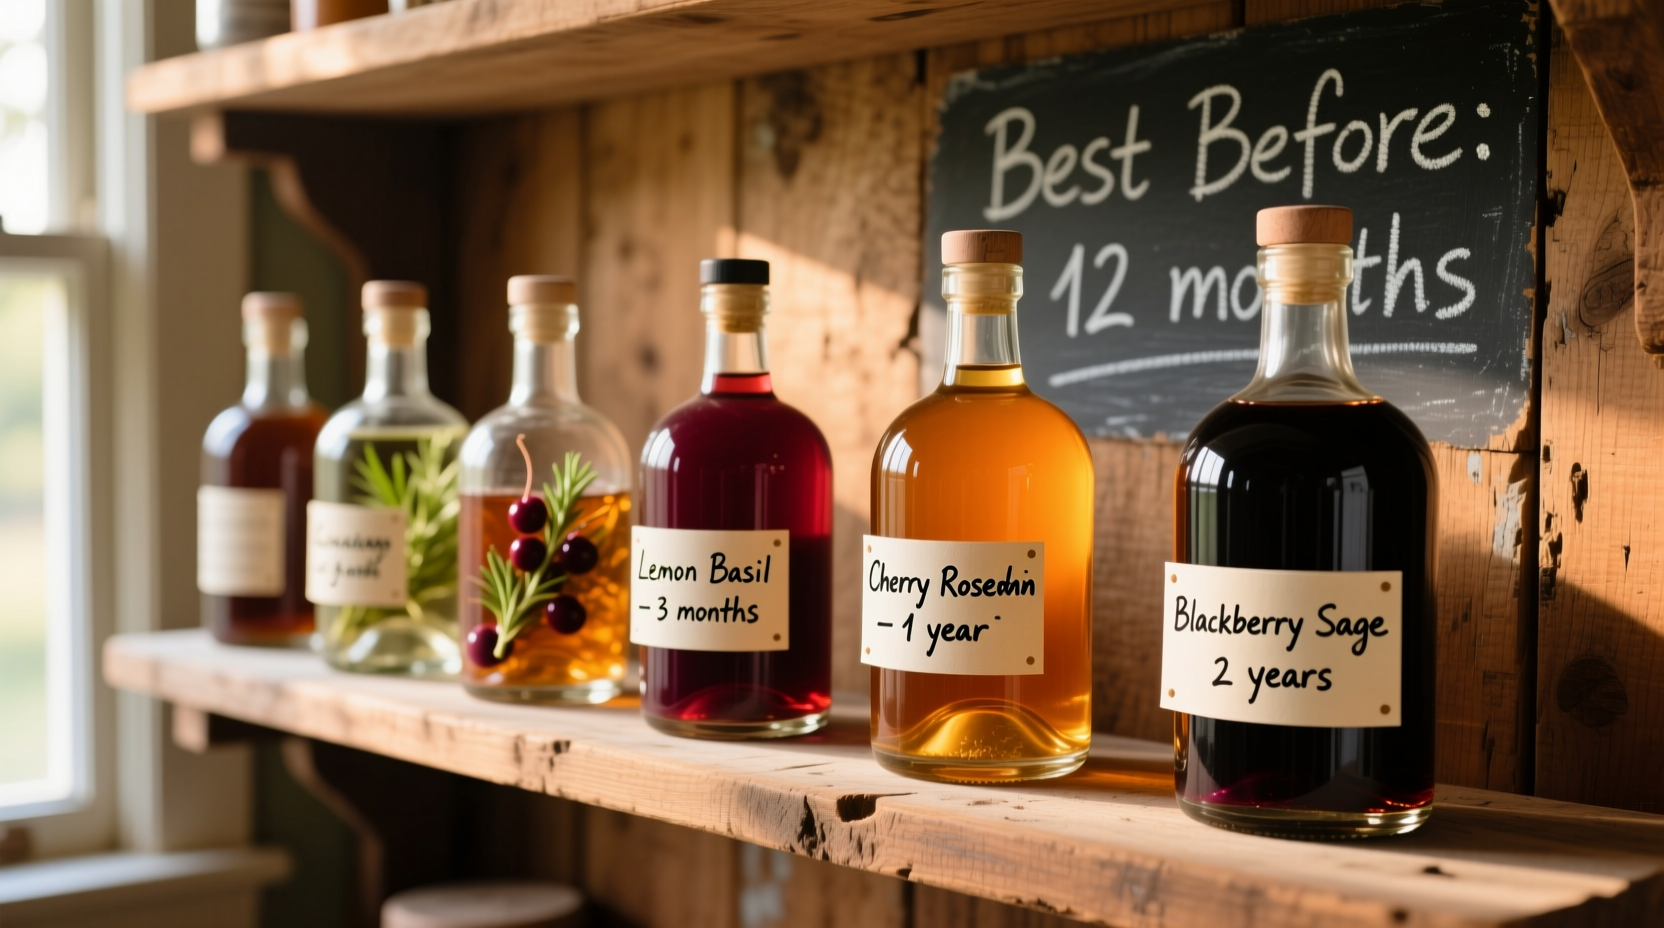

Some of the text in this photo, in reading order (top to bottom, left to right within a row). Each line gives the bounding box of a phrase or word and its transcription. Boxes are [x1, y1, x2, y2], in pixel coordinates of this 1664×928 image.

[983, 68, 1491, 221] Best Before:
[1049, 212, 1477, 338] 12 moths
[638, 548, 771, 584] Lemon Basil
[869, 559, 931, 609] Cherry
[656, 596, 669, 621] 3
[676, 595, 759, 624] months
[902, 612, 915, 642] 1
[1174, 595, 1389, 657] Blackberry Sage
[1211, 656, 1333, 705] 2 years
